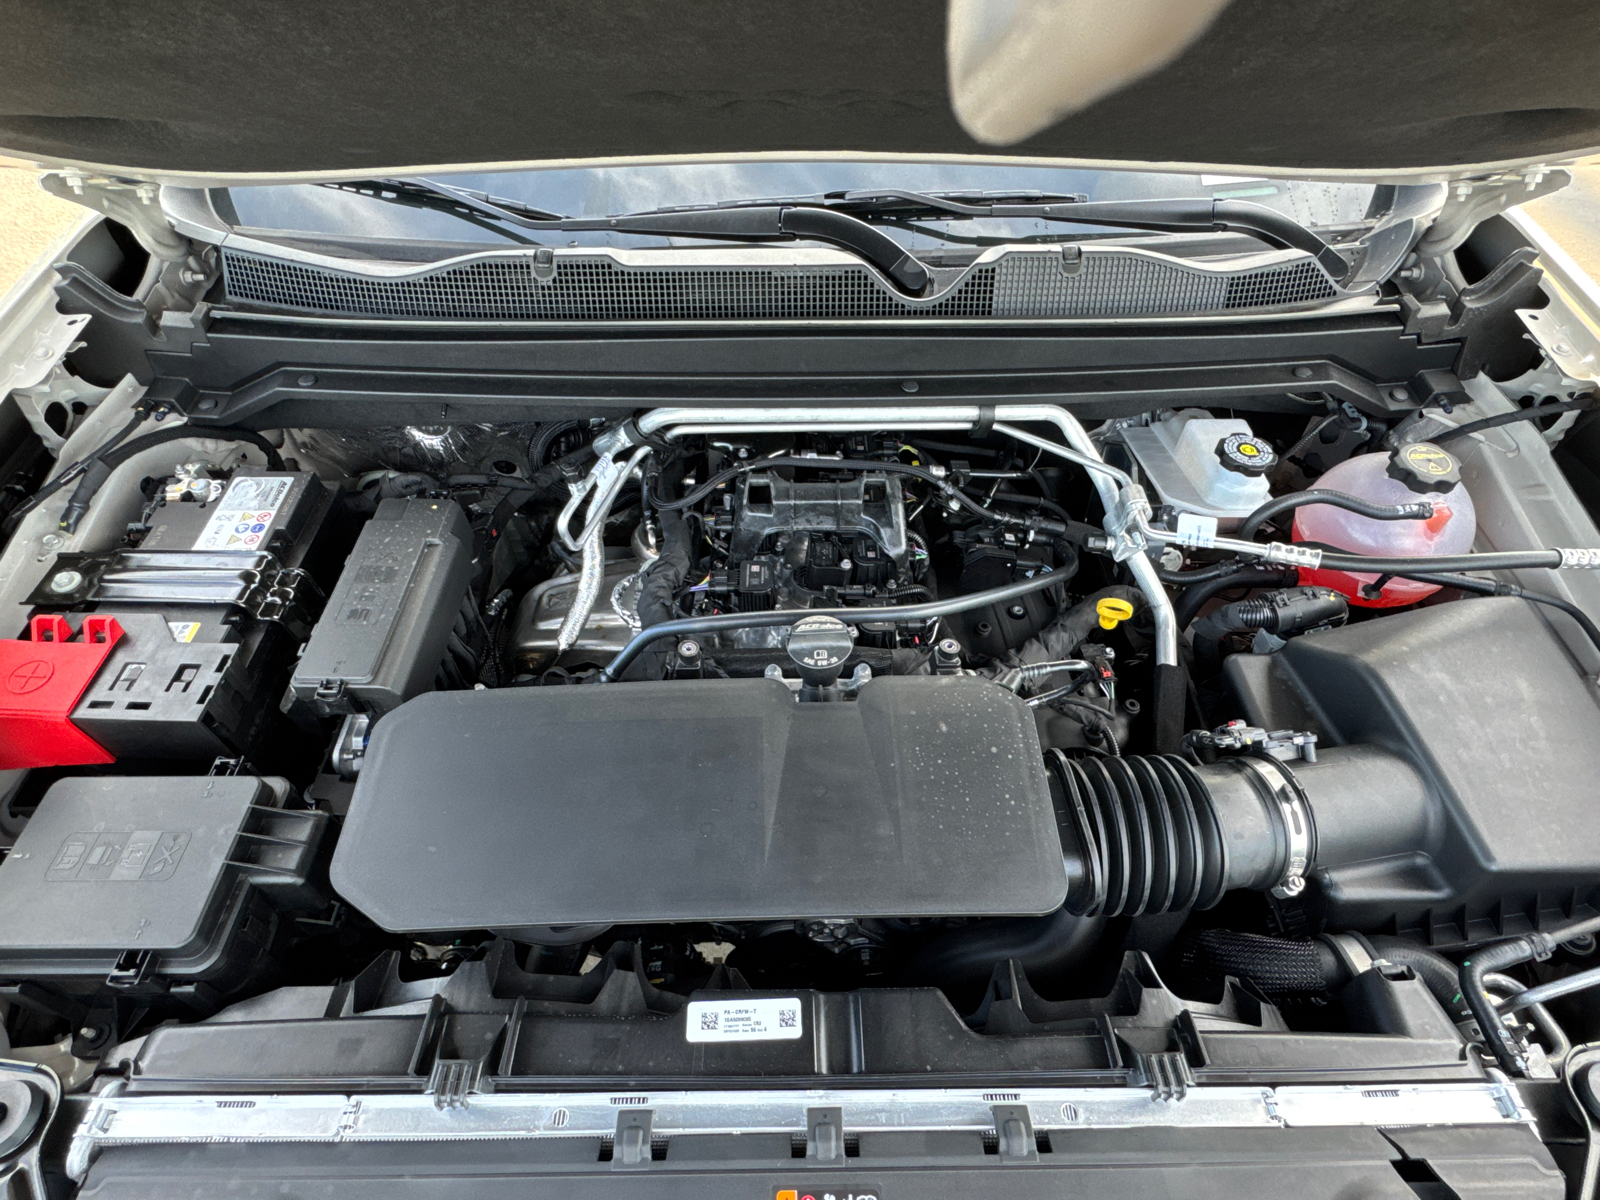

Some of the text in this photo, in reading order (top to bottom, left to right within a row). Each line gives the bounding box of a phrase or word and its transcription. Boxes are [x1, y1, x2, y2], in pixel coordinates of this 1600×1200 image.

[270, 480, 288, 508] ACDelco
[795, 623, 844, 632] ACDelco
[803, 657, 816, 665] SAE
